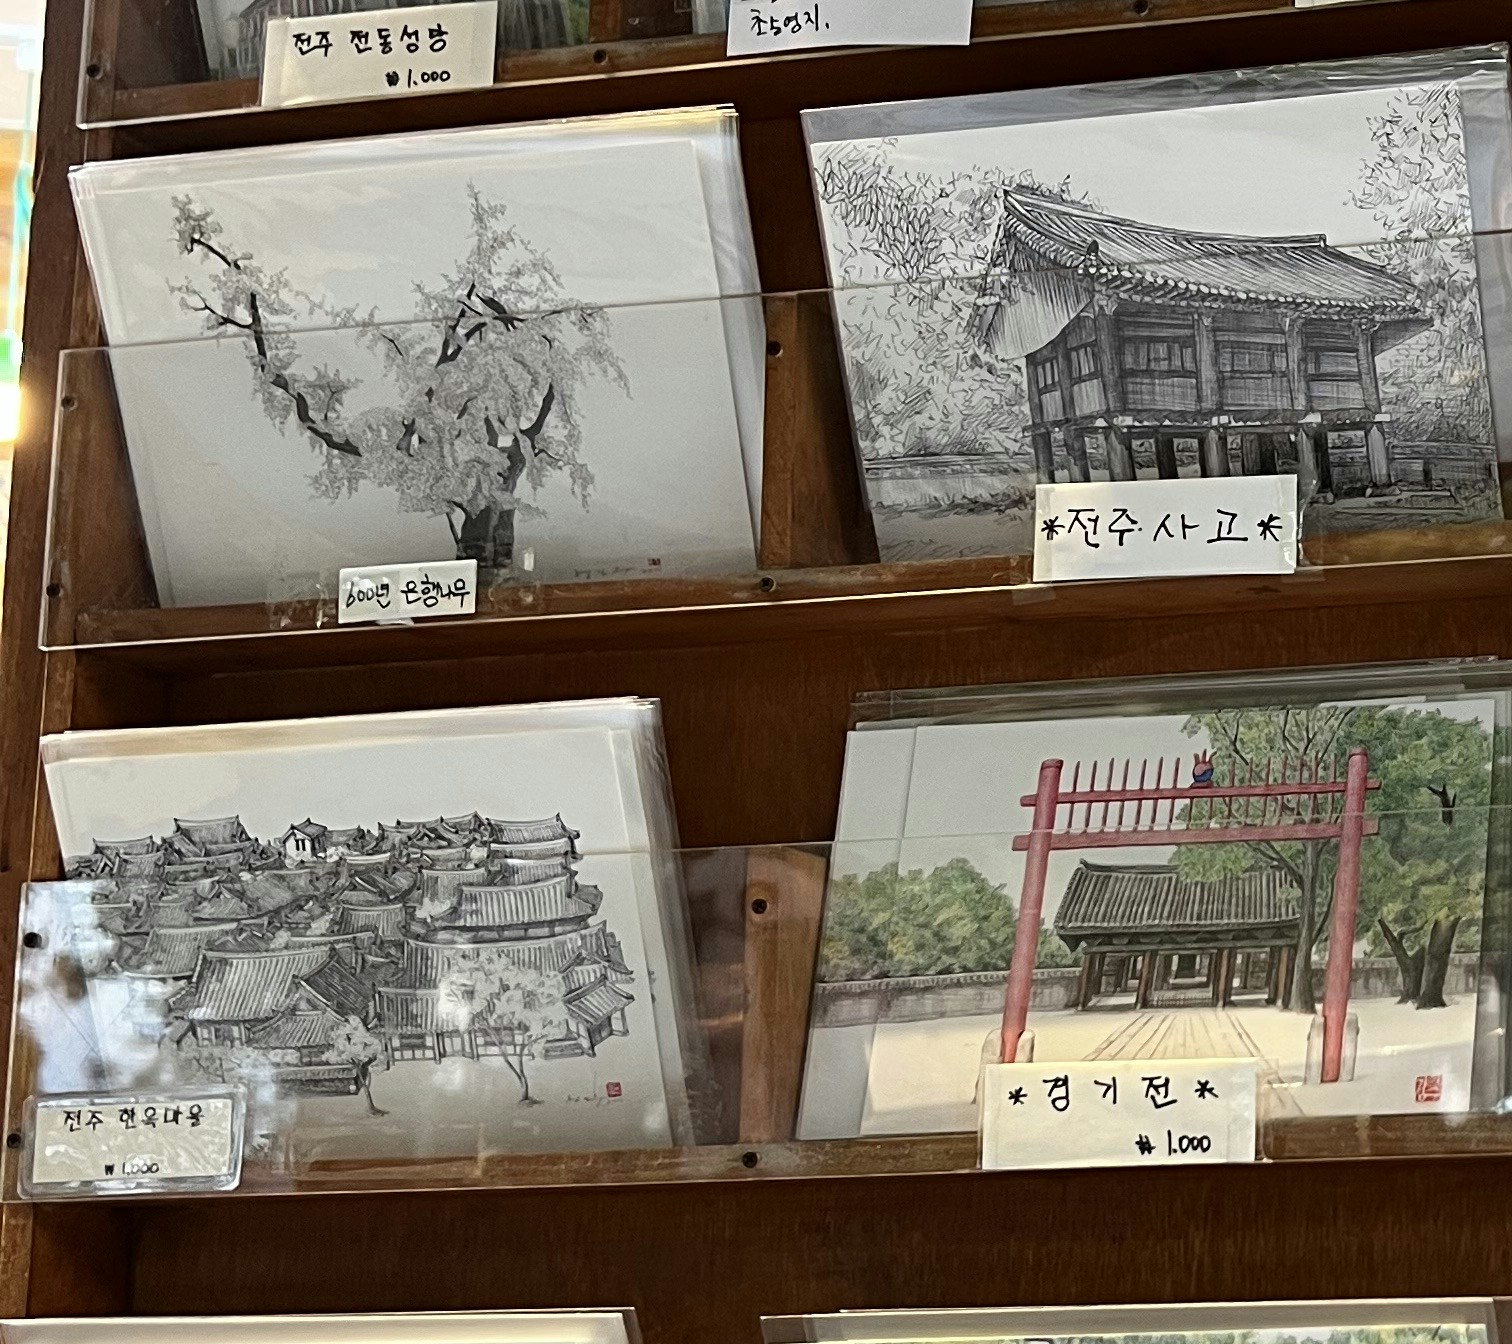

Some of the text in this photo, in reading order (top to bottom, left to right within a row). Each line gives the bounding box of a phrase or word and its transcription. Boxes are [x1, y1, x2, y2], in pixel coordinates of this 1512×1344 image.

[292, 22, 449, 58] 전주 전동성당
[400, 573, 471, 608] 은행나무
[62, 1103, 206, 1133] 전주 한옥마을
